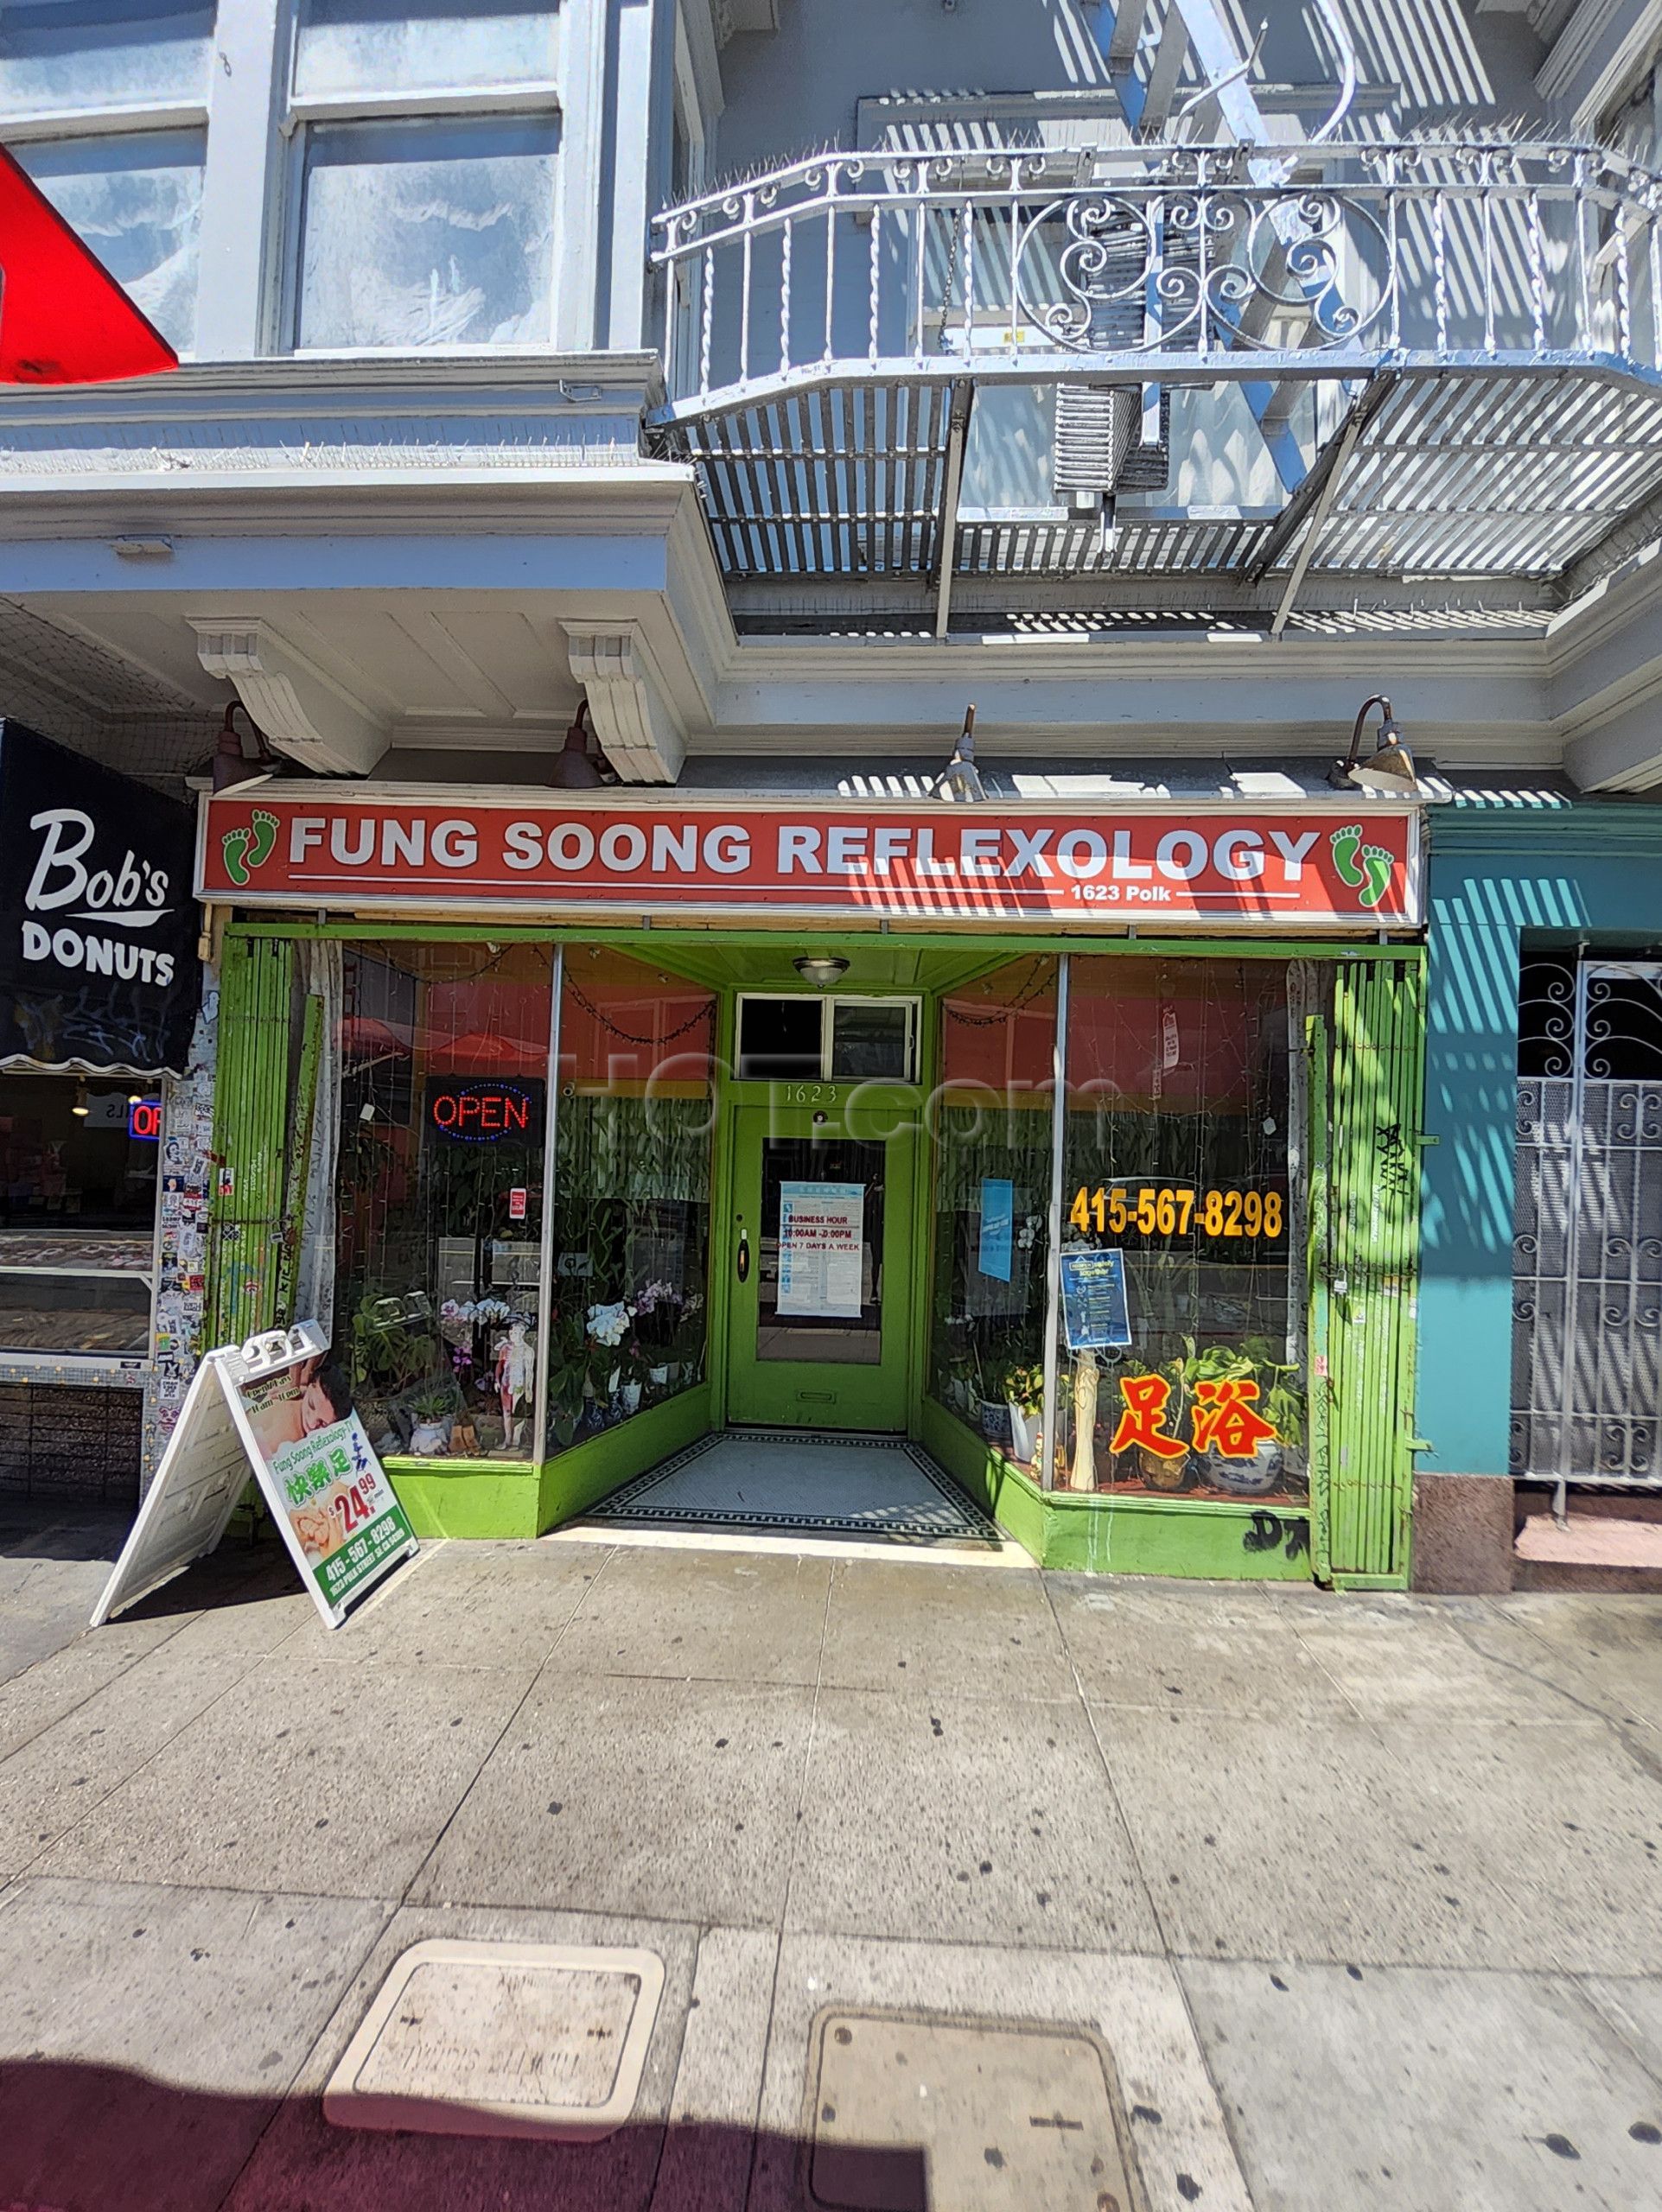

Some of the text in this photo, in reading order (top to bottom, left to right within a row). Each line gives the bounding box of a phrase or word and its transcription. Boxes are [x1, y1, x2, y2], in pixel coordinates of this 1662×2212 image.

[25, 809, 169, 911] Bob's
[290, 817, 1321, 881] FUNG SOONG REFLEXOLOGY
[1071, 884, 1172, 901] 1623 Polk
[22, 920, 175, 987] DONUTS
[434, 1096, 528, 1128] OPEN
[786, 1084, 837, 1103] 1623
[788, 1214, 848, 1224] BUSINESS HOUR
[1070, 1186, 1283, 1237] 415-567-8298
[806, 1242, 826, 1250] DAYS
[837, 1243, 860, 1251] WEEK
[1110, 1374, 1277, 1459] 足浴
[273, 1457, 293, 1474] Fung
[290, 1444, 313, 1465] Soong
[326, 1556, 346, 1580] 415
[347, 1537, 368, 1563] 567
[370, 1516, 396, 1544] 8298
